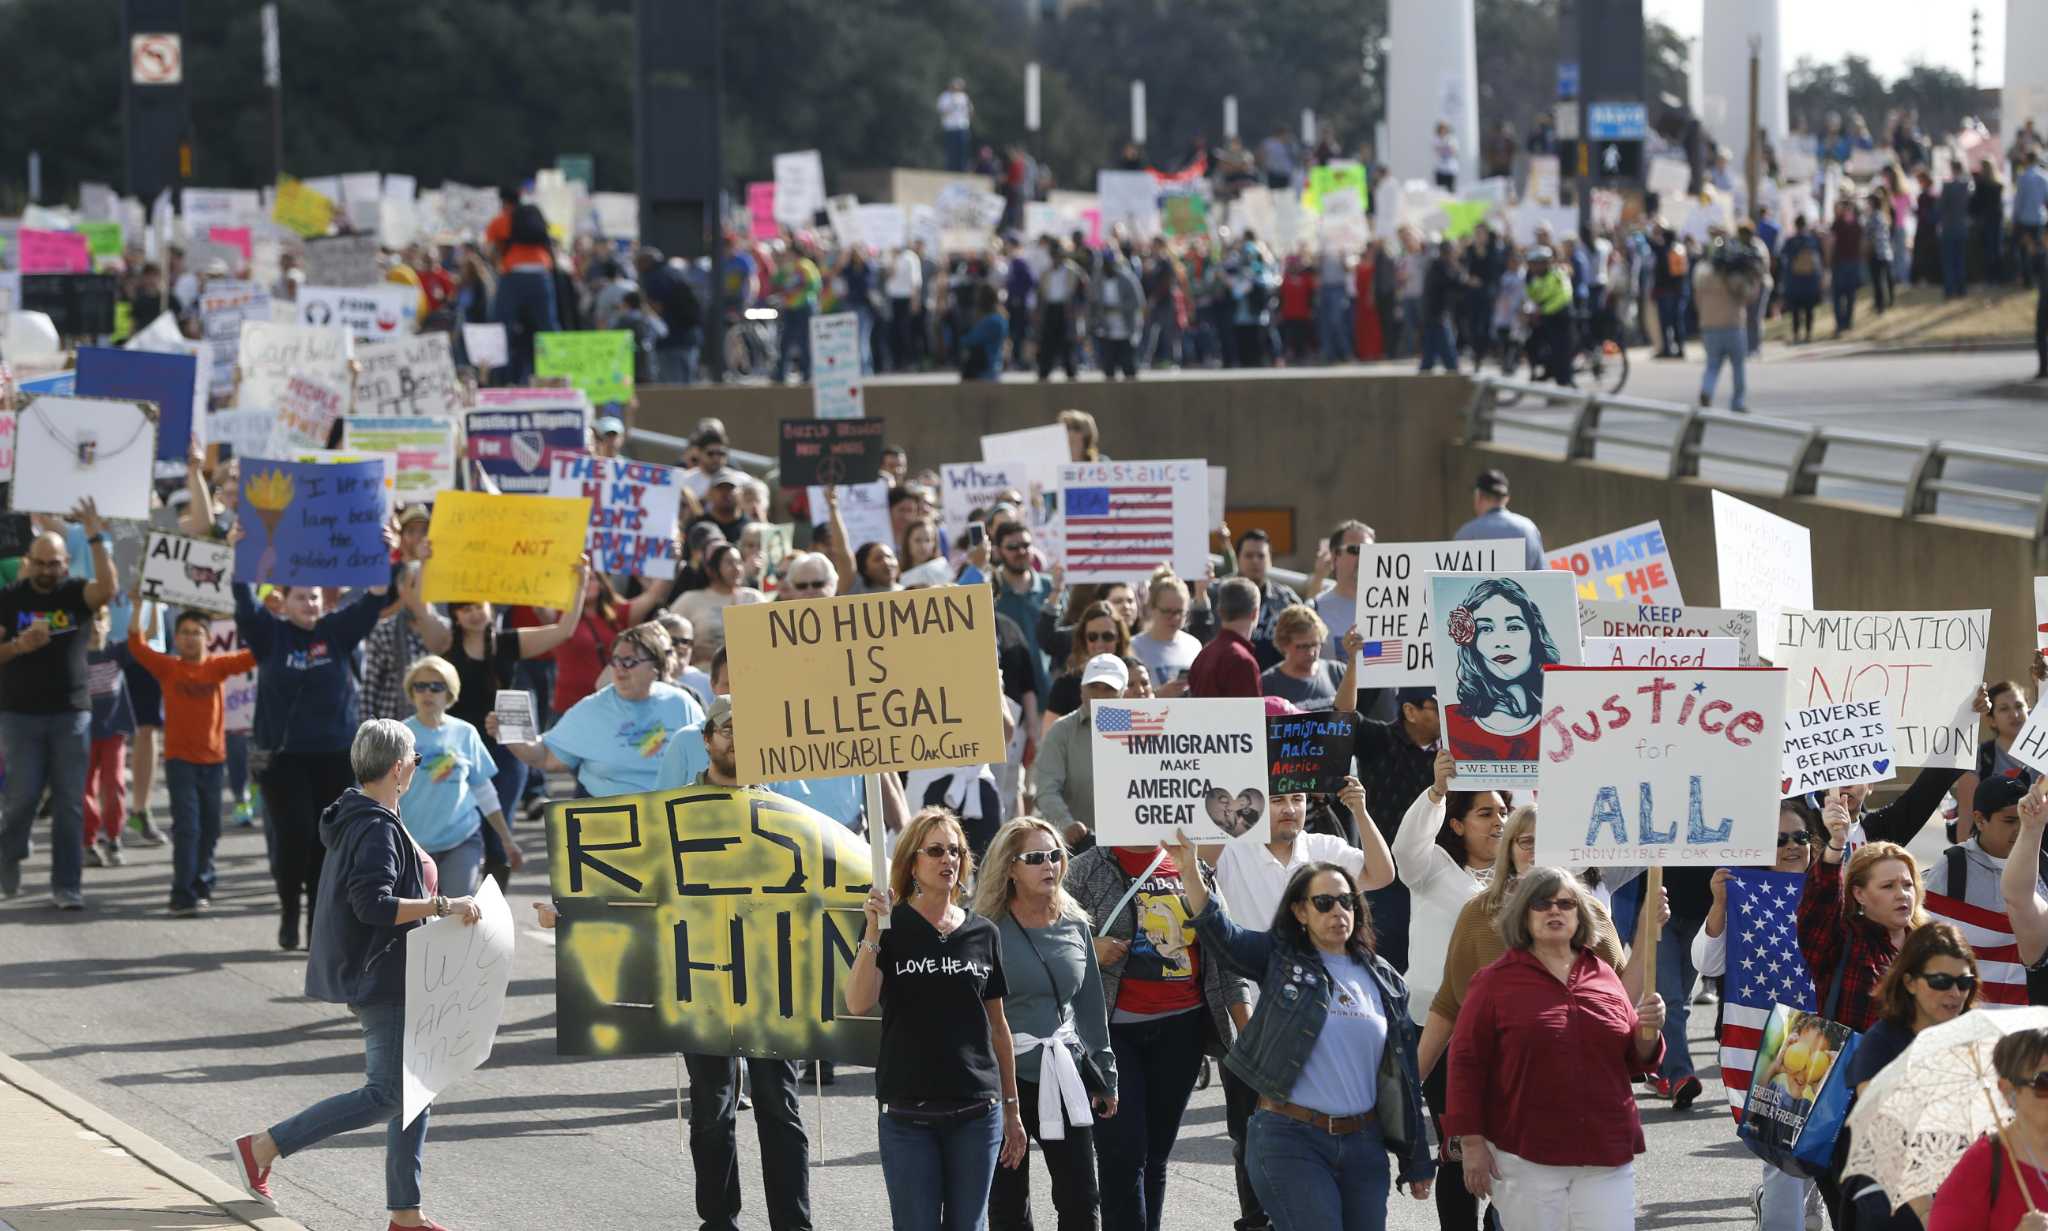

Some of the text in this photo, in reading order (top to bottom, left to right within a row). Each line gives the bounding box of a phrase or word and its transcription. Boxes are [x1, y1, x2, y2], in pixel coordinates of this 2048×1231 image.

[554, 454, 608, 481] THE
[610, 483, 646, 507] MY
[151, 537, 192, 562] All
[511, 539, 554, 556] NOT
[1548, 529, 1667, 577] NO HATE
[1375, 553, 1411, 580] NO
[1606, 562, 1669, 599] THE
[1366, 585, 1410, 608] CAN
[768, 594, 975, 648] NO HUMAN
[1366, 614, 1409, 637] THE
[1638, 605, 1682, 623] KEEP
[1603, 620, 1709, 638] DEMOCRACY
[1778, 612, 1986, 651] IMMIGRATION
[846, 645, 888, 687] IS
[1407, 643, 1434, 671] DR
[1611, 645, 1707, 667] A closed
[1808, 664, 1934, 718] NOT
[784, 686, 963, 738] ILLEGAL
[1798, 700, 1882, 728] DIVERSE
[1128, 733, 1254, 755] IMMIGRANTS
[1859, 722, 1885, 739] IS
[1895, 724, 1974, 757] TION
[759, 734, 904, 776] INDIVISABLE
[1635, 737, 1679, 760] for
[1796, 741, 1888, 770] BEAUTIFUL
[1160, 759, 1201, 772] MAKE
[1464, 763, 1539, 774] WE THE PE
[1799, 763, 1872, 790] AMERICA
[1127, 778, 1215, 800] AMERICA
[1135, 804, 1196, 825] GREAT
[1585, 774, 1734, 846] ALL
[565, 793, 873, 897] RESI
[1569, 847, 1764, 862] INDIVISIBLE OAK CLIFF
[424, 921, 497, 994] WE
[895, 955, 993, 981] LOVE HEALS
[414, 975, 489, 1047] ARE
